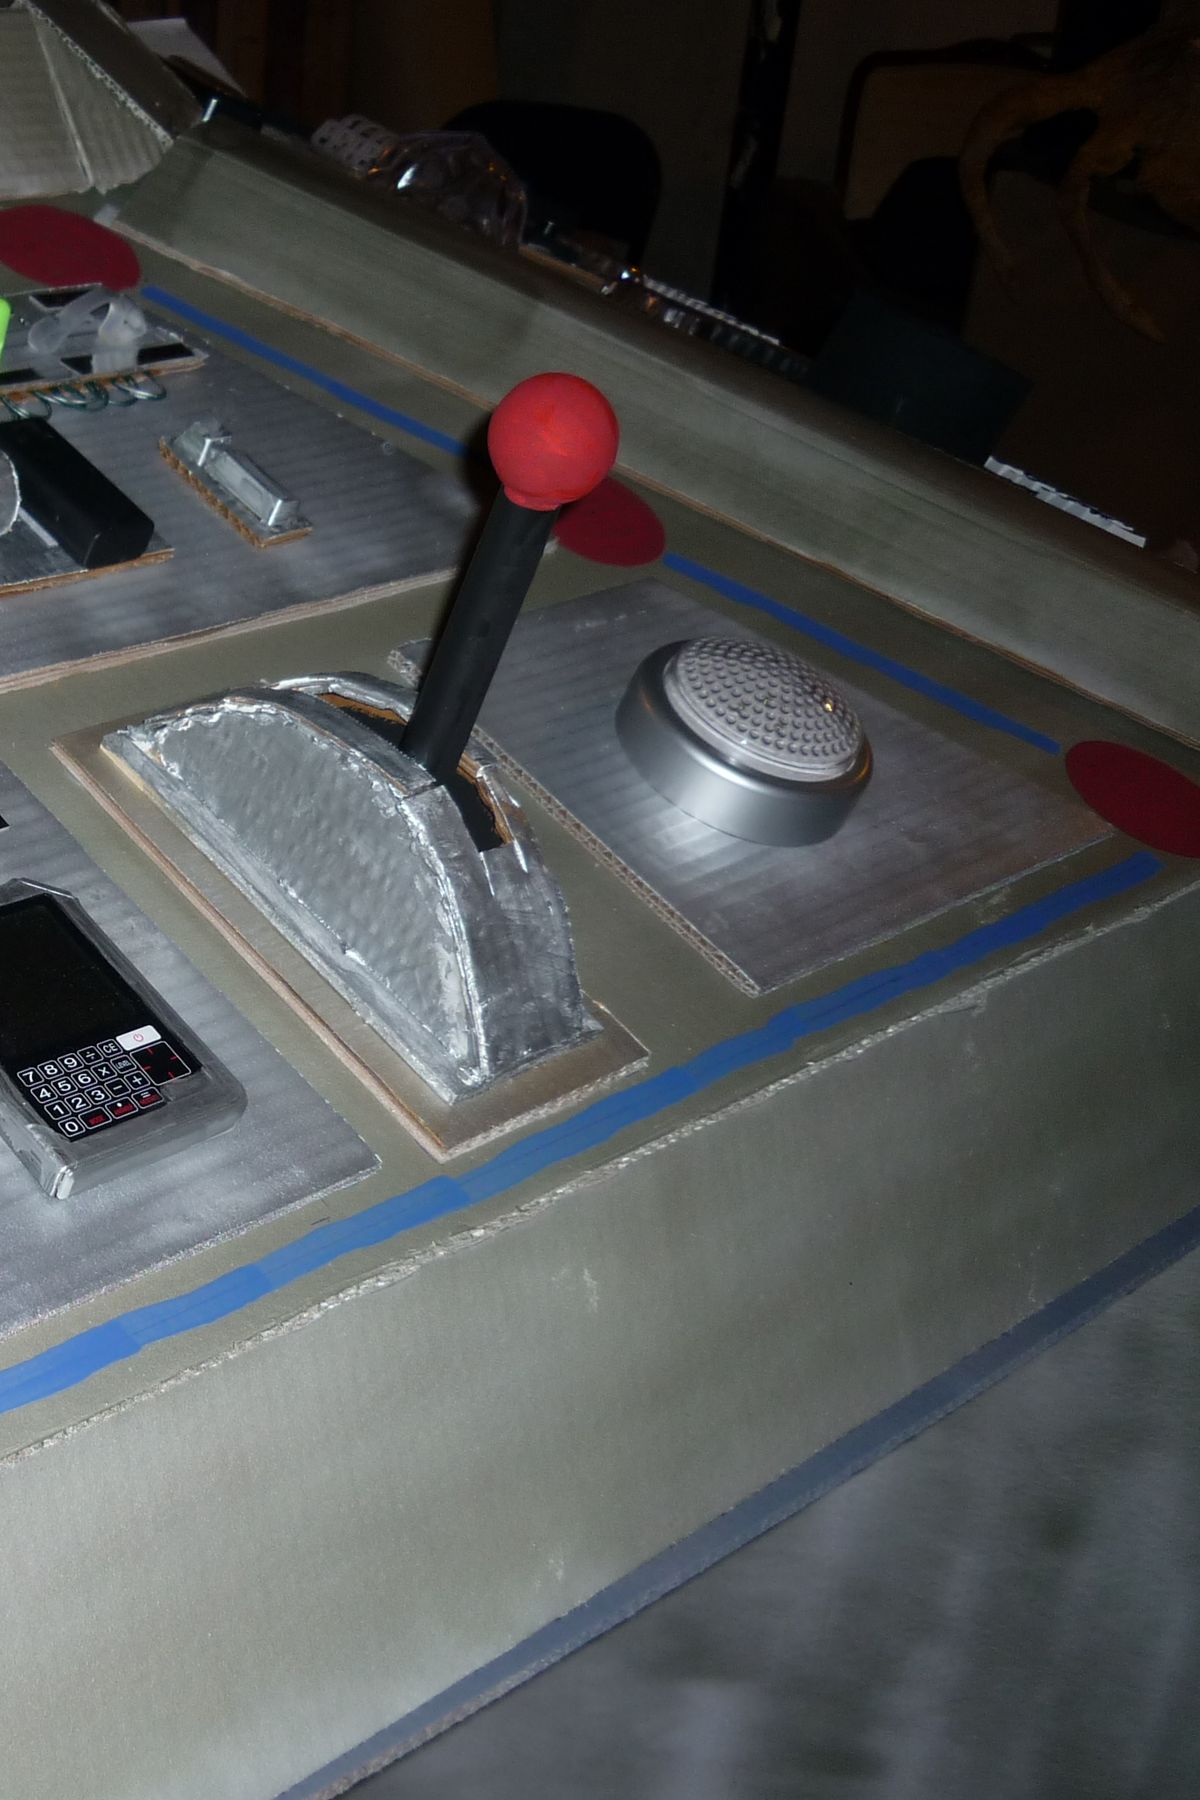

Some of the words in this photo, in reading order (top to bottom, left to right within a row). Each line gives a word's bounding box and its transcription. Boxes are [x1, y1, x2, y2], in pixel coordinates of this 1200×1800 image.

[103, 1042, 118, 1054] CE
[64, 1057, 77, 1069] 9
[45, 1063, 58, 1076] 8
[23, 1071, 35, 1083] 7
[77, 1073, 92, 1085] 6
[58, 1080, 72, 1092] 5
[39, 1088, 52, 1100] 4
[91, 1089, 105, 1101] 3
[71, 1097, 86, 1110] 2
[52, 1104, 64, 1116] 1
[66, 1121, 79, 1133] 0
